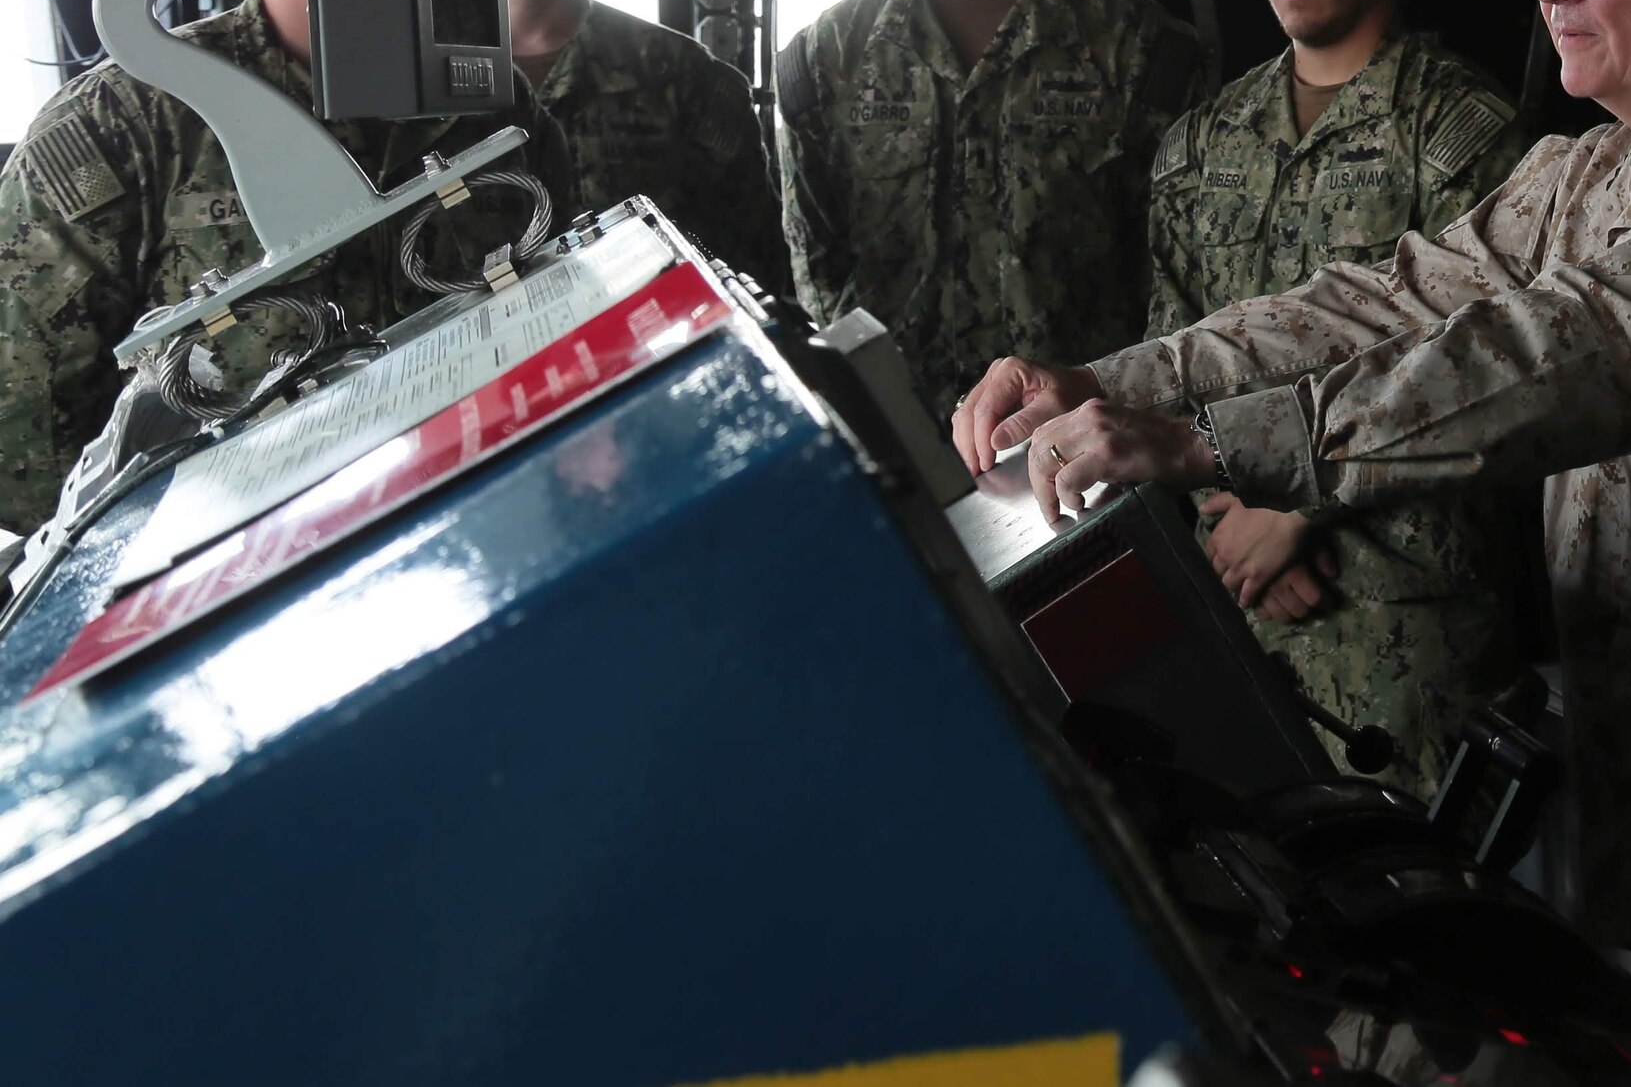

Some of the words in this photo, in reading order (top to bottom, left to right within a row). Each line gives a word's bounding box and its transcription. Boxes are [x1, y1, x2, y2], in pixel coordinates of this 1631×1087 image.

[849, 104, 911, 123] O'GARRO
[1064, 100, 1103, 116] NAVY
[1205, 172, 1248, 190] RIBERA
[1356, 170, 1396, 187] NAVY
